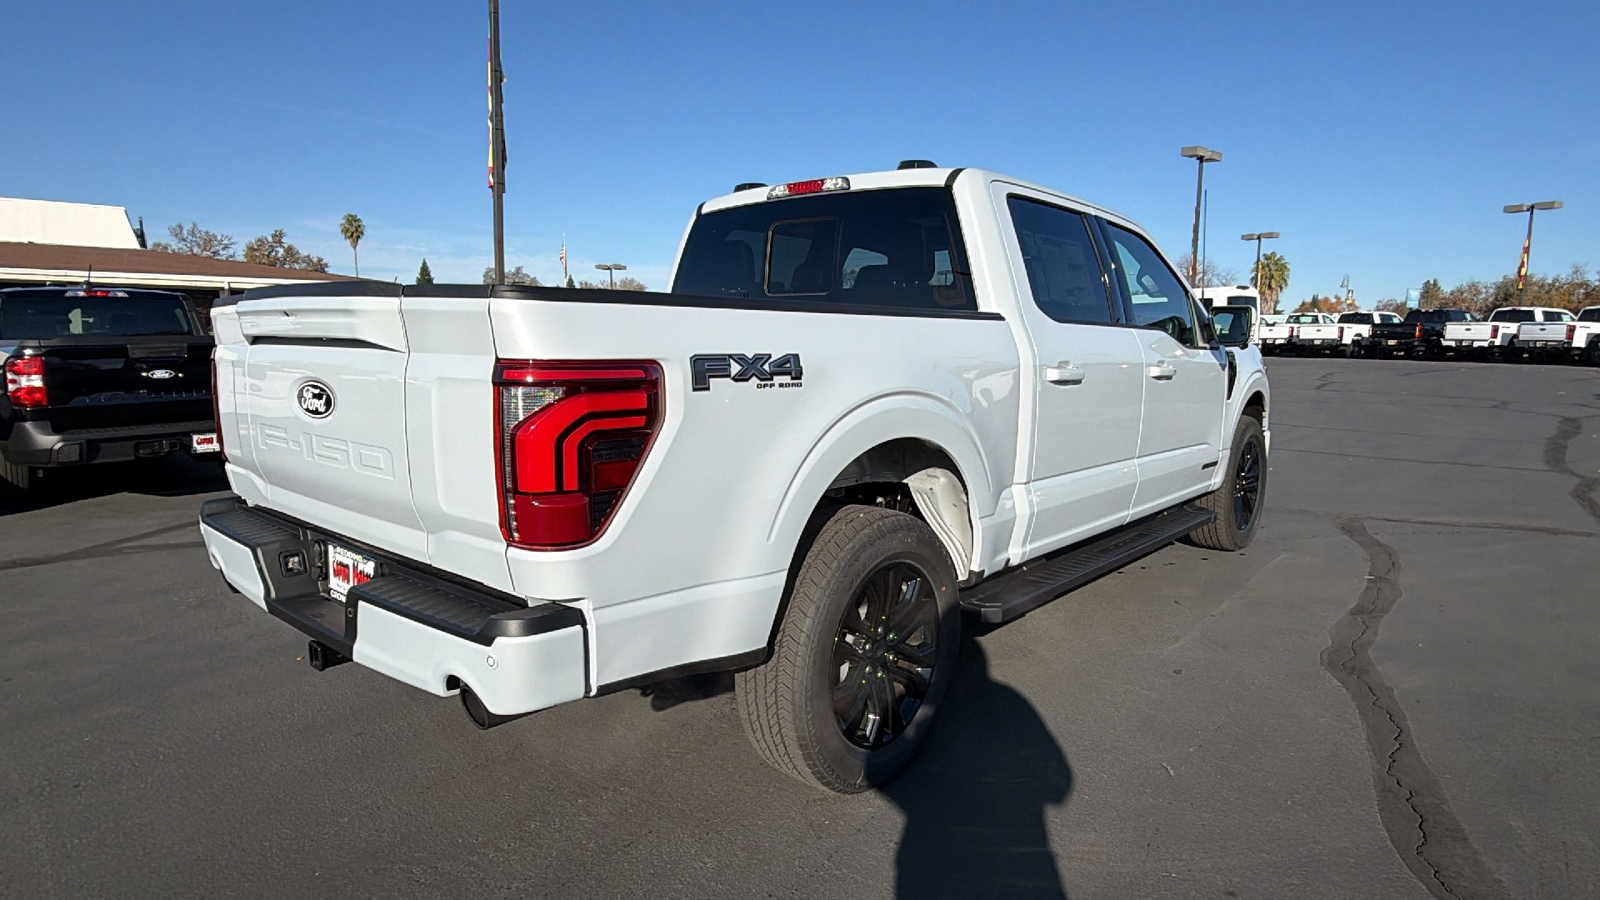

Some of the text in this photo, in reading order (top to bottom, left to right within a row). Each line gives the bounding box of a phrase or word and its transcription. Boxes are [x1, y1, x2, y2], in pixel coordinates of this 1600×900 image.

[690, 353, 803, 392] FX4
[302, 387, 326, 412] Ford
[258, 423, 395, 480] F-150
